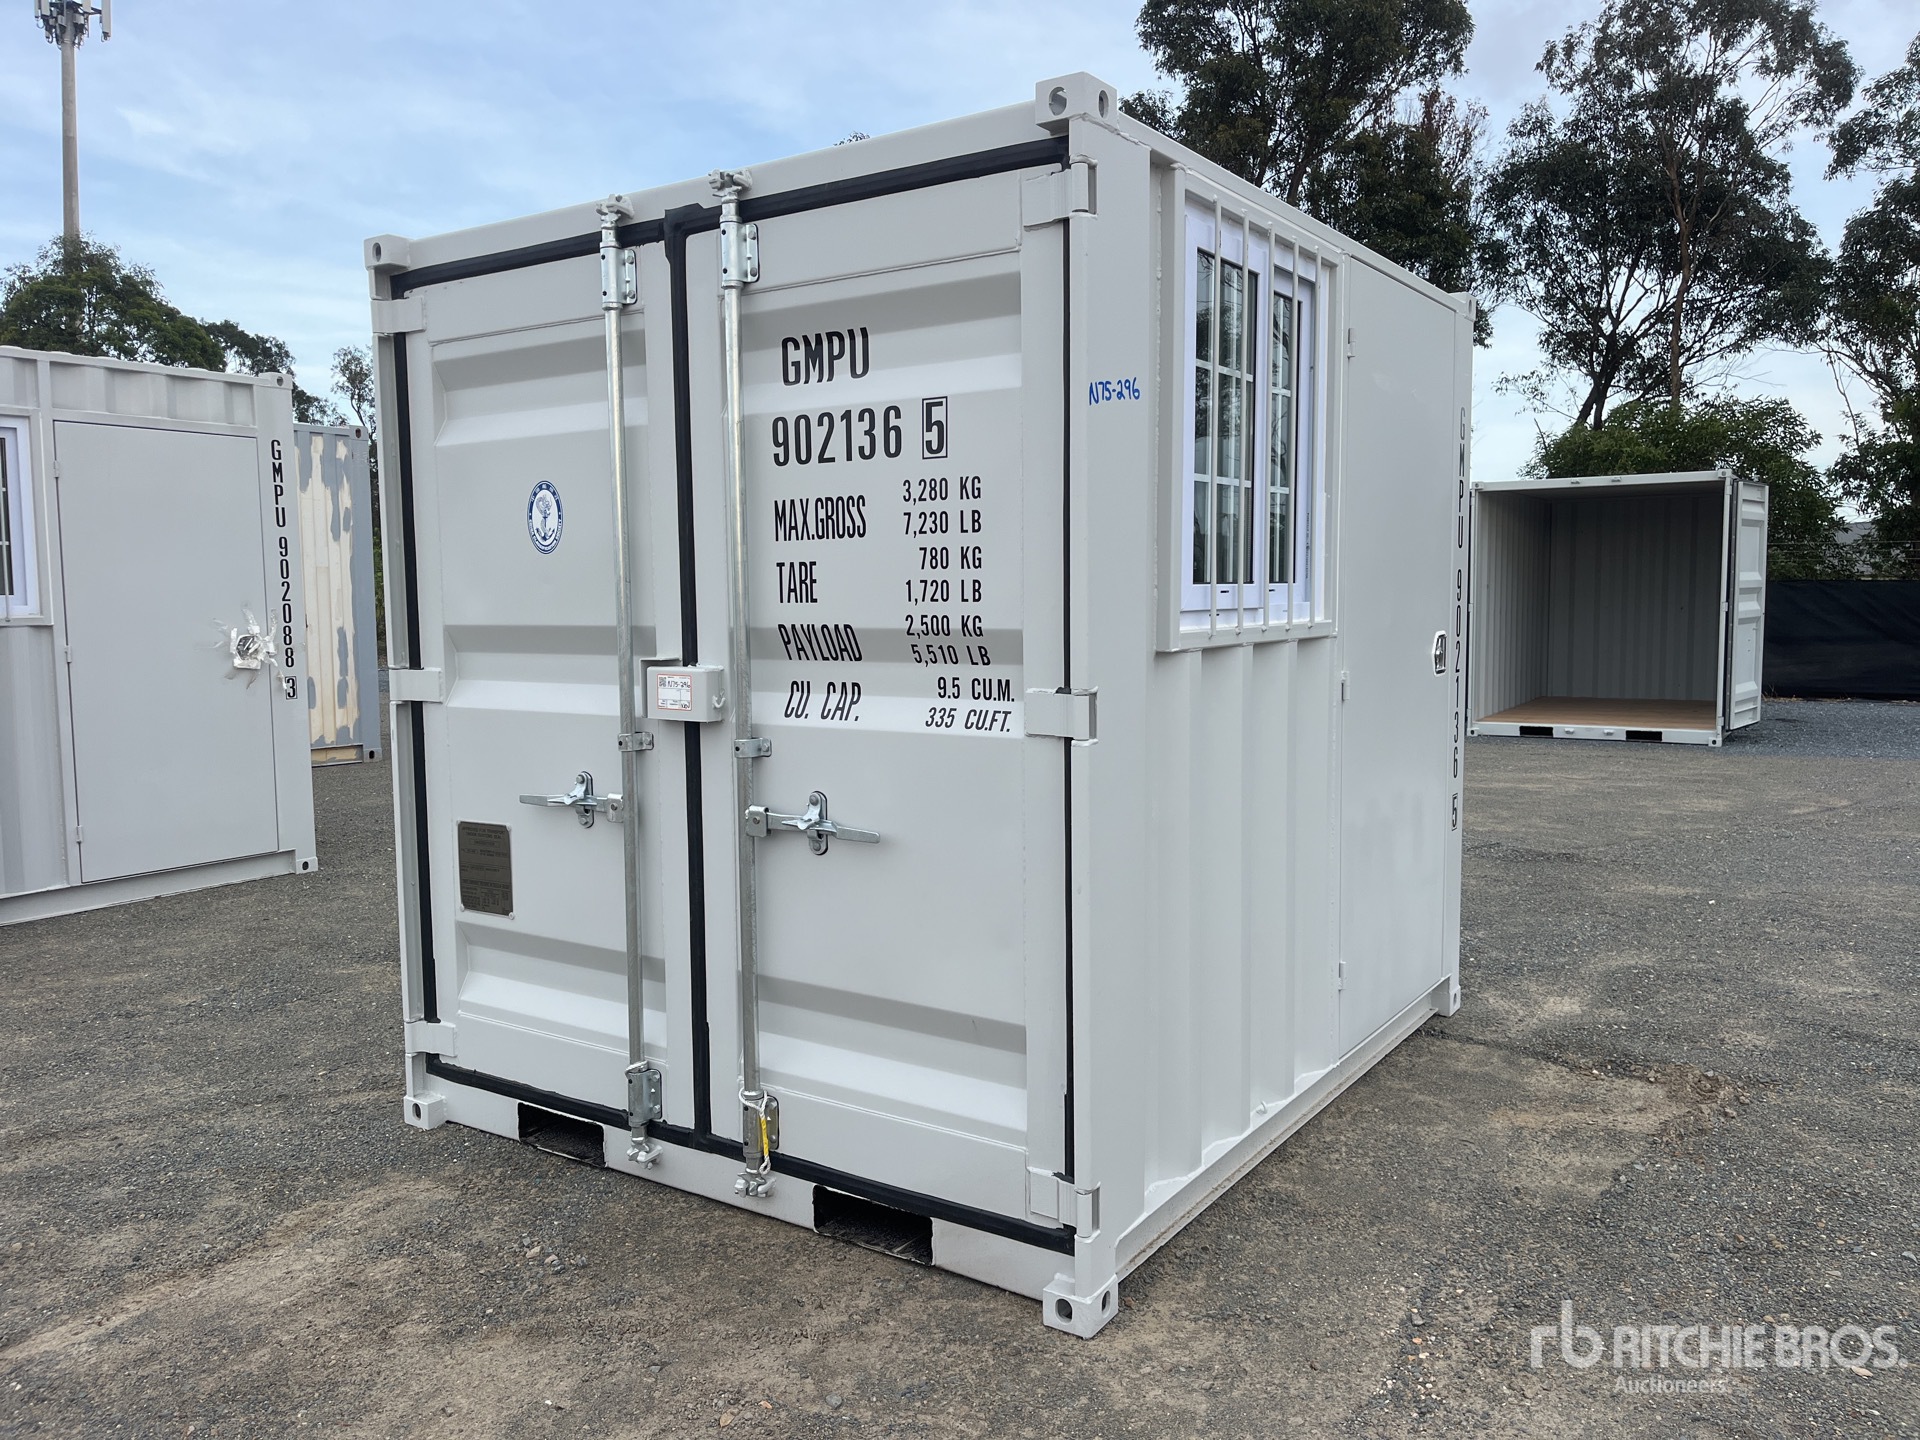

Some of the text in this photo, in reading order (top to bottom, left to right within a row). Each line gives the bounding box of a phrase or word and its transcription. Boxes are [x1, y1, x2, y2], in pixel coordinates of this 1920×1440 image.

[781, 326, 870, 386] GMPU
[1089, 377, 1140, 405] N75-296
[771, 398, 947, 466] 902136 5
[902, 475, 981, 505] 3,280 KG
[774, 494, 866, 541] MAX.GROSS
[903, 510, 982, 538] 7,230 LB
[271, 439, 297, 699] GMPU 902088 3
[919, 546, 982, 570] 780 KG
[776, 561, 818, 603] TARE
[905, 579, 982, 606] 1,720 LB
[905, 615, 983, 639] 2,500 KG
[1452, 406, 1466, 830] GMPU 902136 5
[778, 624, 863, 661] PAYLOAD
[910, 644, 991, 667] 5,510 LB
[784, 680, 862, 721] CU. CAP.
[937, 676, 1015, 702] 9.5 CU.M.
[925, 707, 1011, 732] 335 CU.FT.
